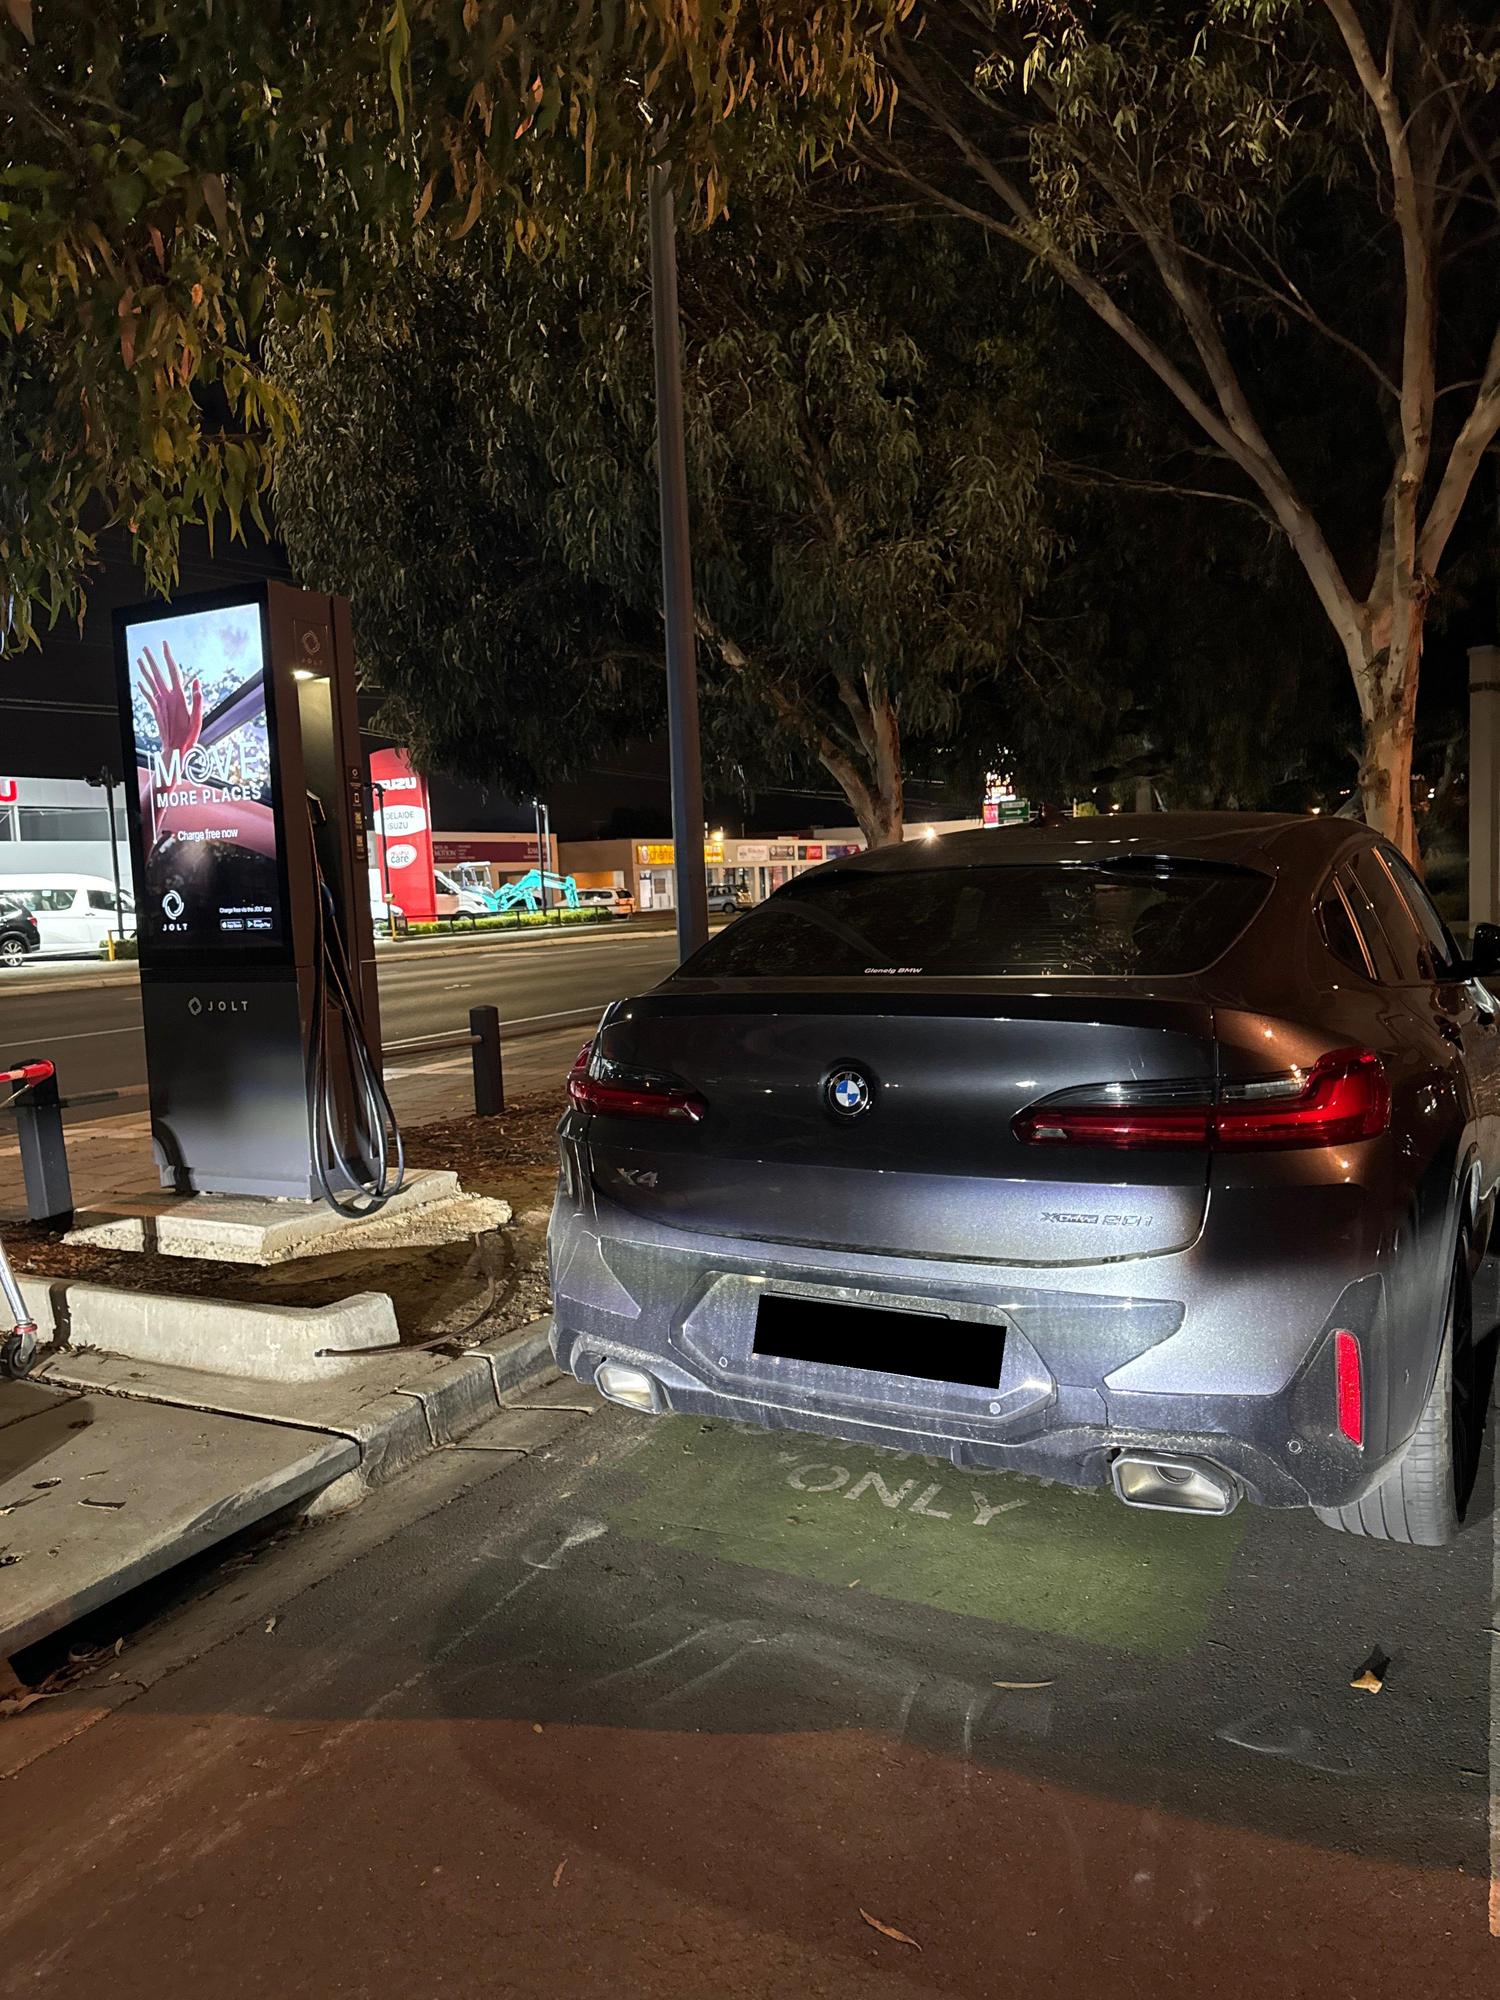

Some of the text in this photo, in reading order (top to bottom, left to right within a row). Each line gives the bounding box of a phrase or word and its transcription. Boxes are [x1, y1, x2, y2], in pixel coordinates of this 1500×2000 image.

[154, 741, 258, 788] MOVE
[156, 784, 262, 808] MORE PLACES
[382, 811, 415, 821] DELAIDE
[178, 829, 238, 842] Charge free now
[390, 855, 409, 864] care
[162, 924, 188, 932] JOLT
[207, 1001, 248, 1012] JOLT
[616, 1167, 658, 1188] X4
[787, 1462, 1031, 1527] ONLY
